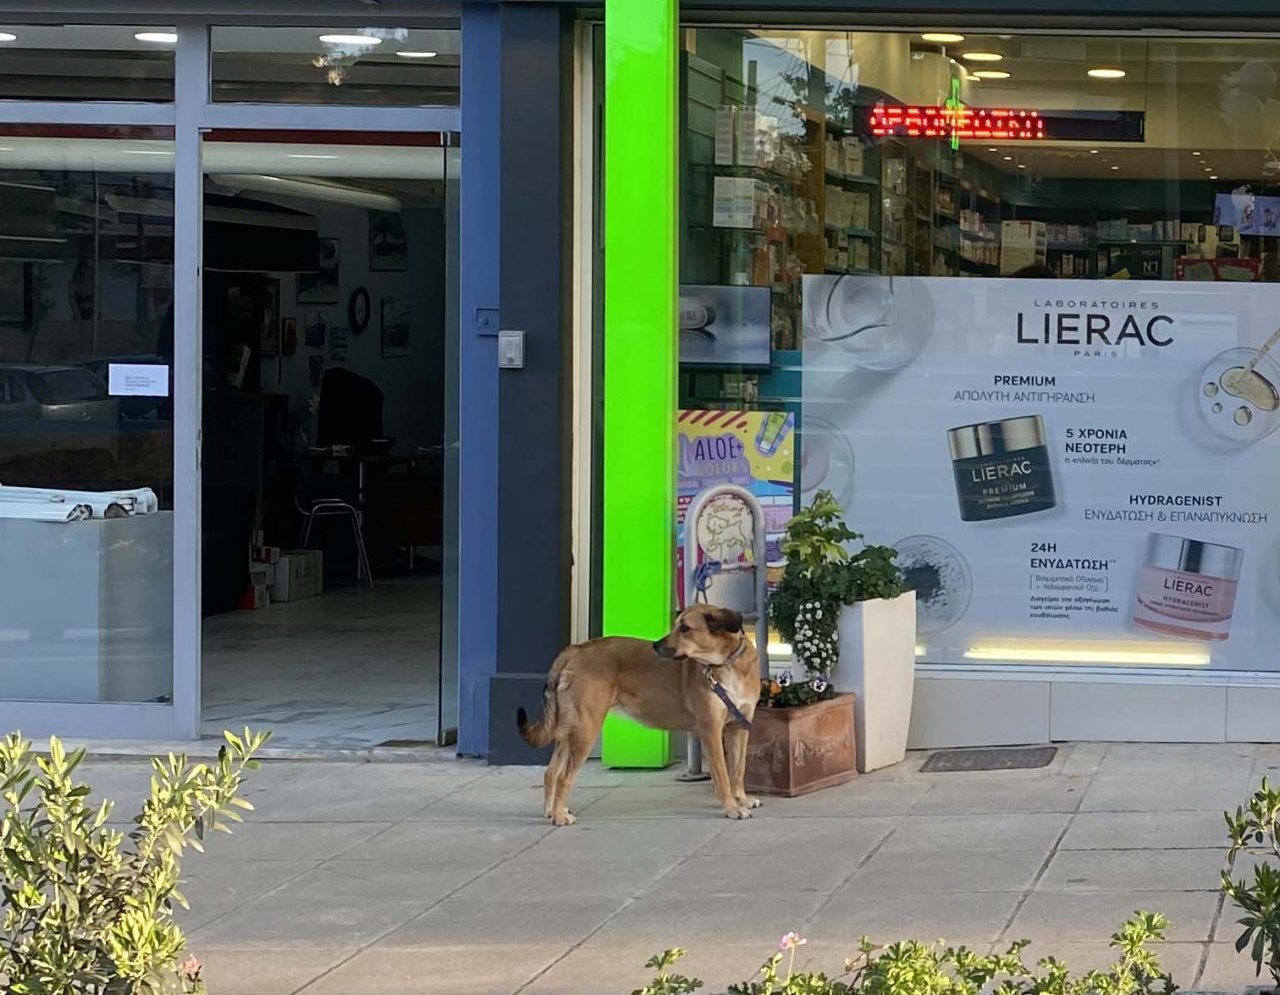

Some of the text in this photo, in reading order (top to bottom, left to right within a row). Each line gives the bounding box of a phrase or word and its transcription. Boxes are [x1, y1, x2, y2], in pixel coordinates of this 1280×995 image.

[1034, 300, 1159, 309] LABORATOIRES
[1017, 313, 1174, 347] LIERAC
[1074, 350, 1117, 358] PARIS
[994, 375, 1056, 387] PREMIUM
[954, 390, 1095, 404] ΑΠΟΛΥΤΗ ΑΝΤΙΓΗΡΑΝΣΗ
[1066, 428, 1128, 440] 5 ΧΡΟΝΙΑ
[1065, 443, 1126, 454] ΝΕΟΤΕΡΗ
[972, 461, 1032, 482] LIERAC
[1129, 494, 1222, 506] HYDRAGENIST
[1085, 509, 1267, 524] ΕΝΥΔΑΤΩΣΗ & ΕΠΑΝΑΠΥΚΝΩΣΗ
[1164, 578, 1213, 596] LIERAC
